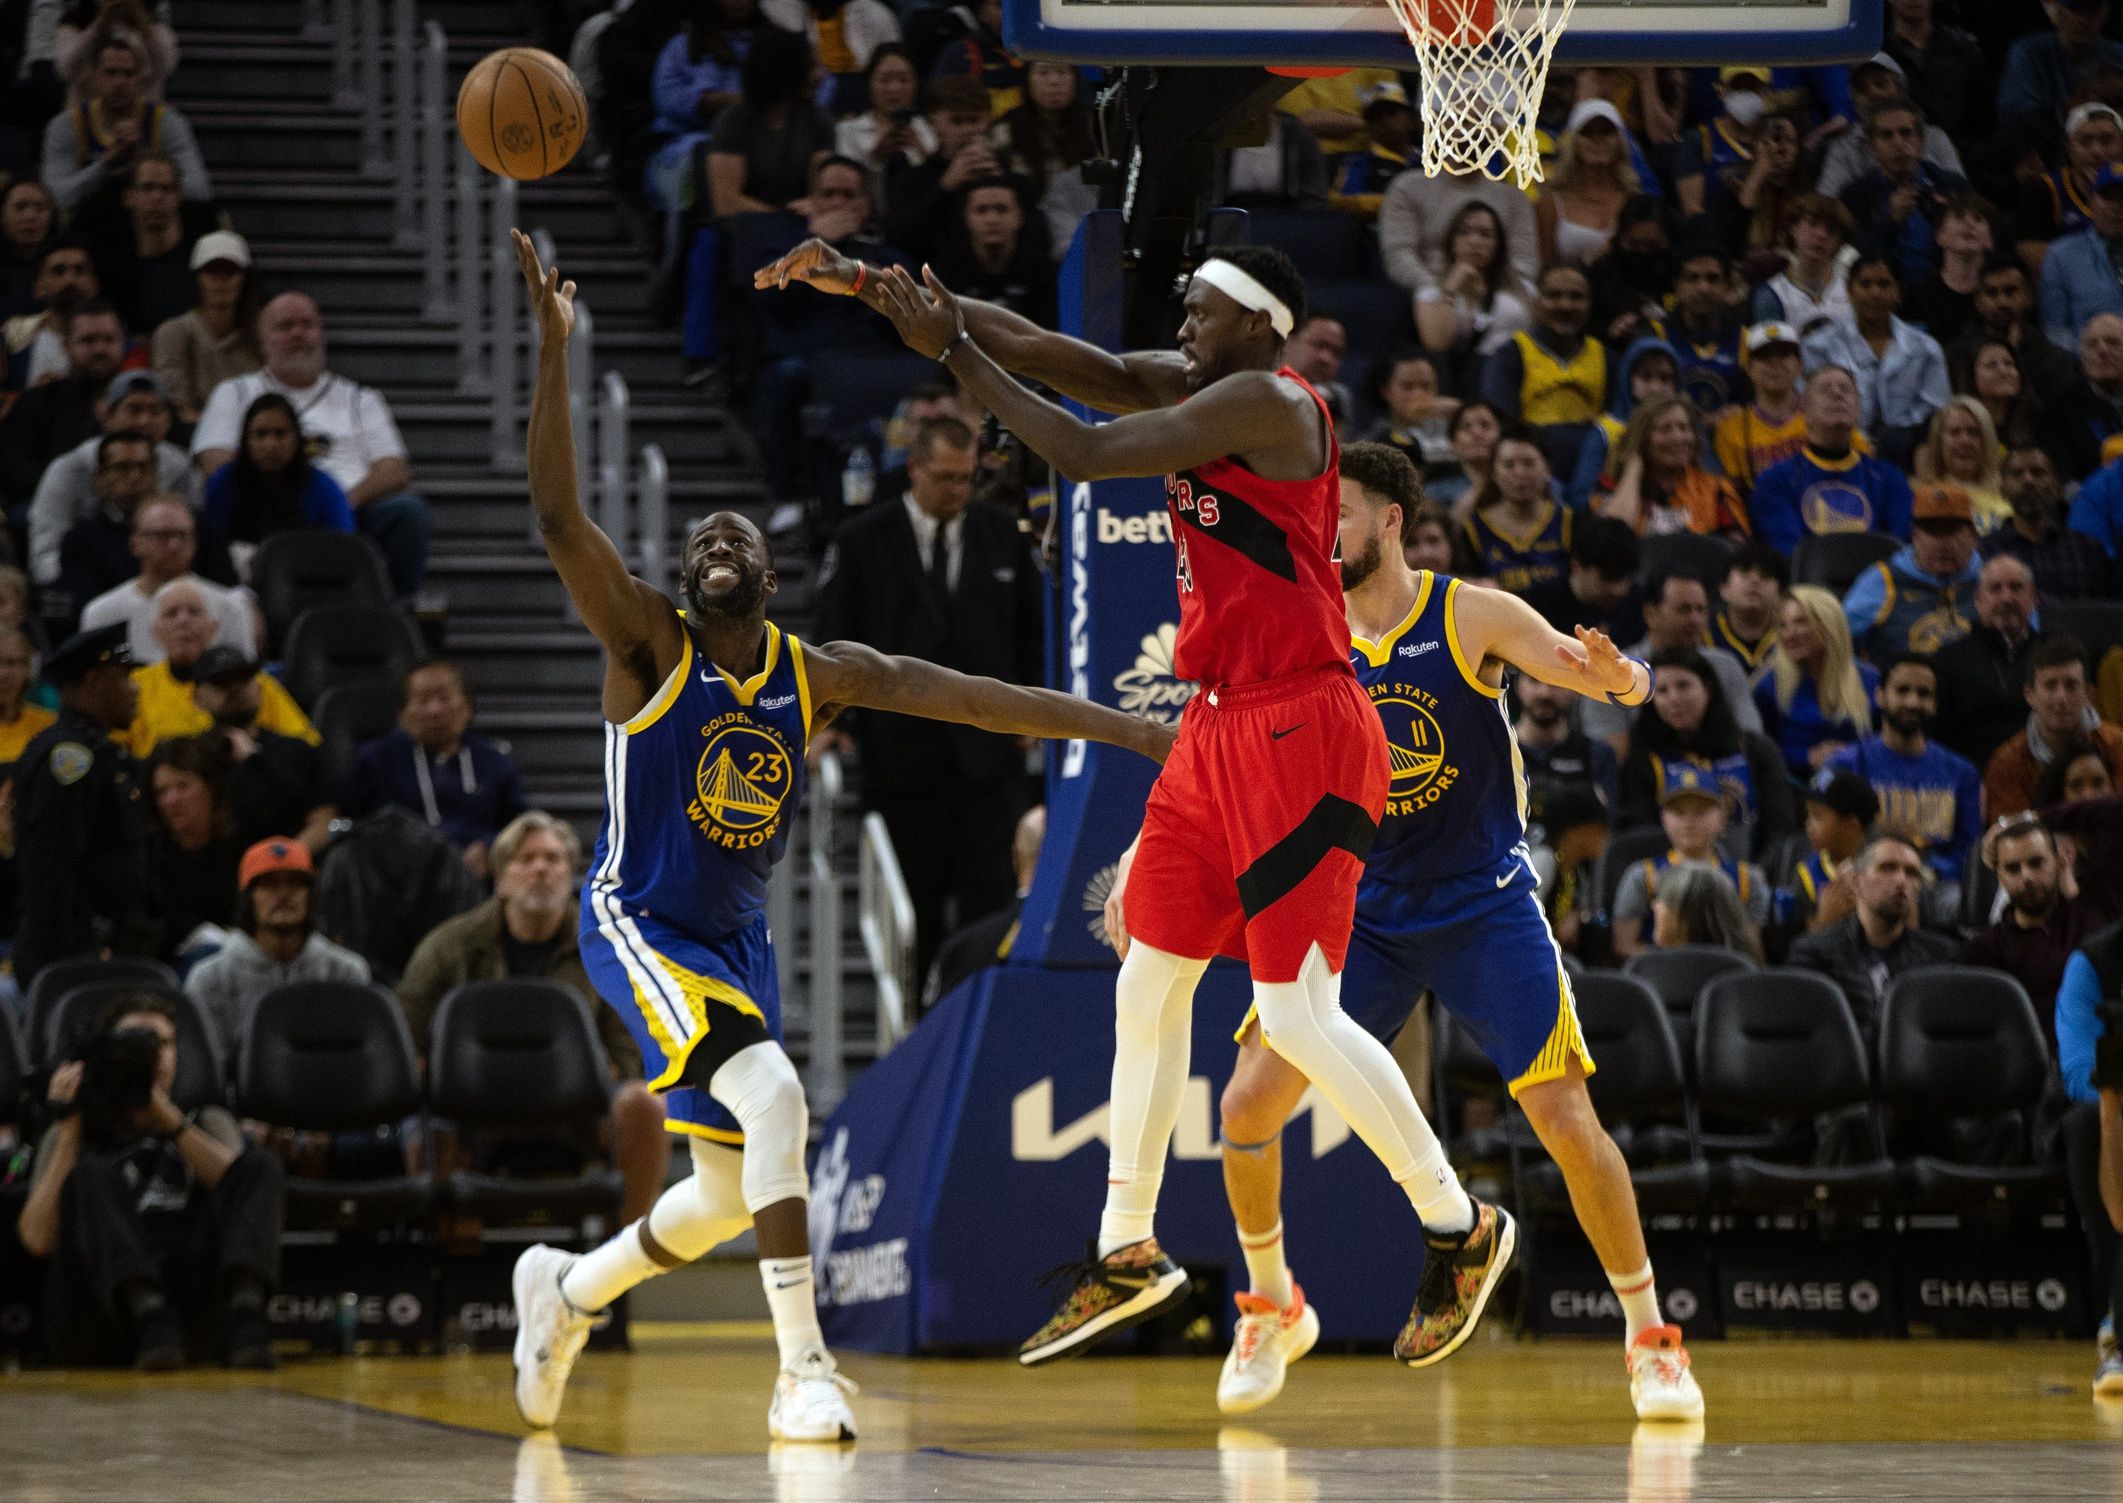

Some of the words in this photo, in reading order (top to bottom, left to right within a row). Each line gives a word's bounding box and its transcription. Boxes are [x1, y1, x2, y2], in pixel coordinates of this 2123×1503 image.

[1397, 640, 1440, 658] Rakuten
[1394, 682, 1439, 710] STATE
[1410, 718, 1429, 748] 11
[745, 751, 784, 783] 23
[685, 798, 782, 850] WARRIORS
[1733, 1281, 1844, 1311] CHASE
[1919, 1278, 2031, 1310] CHASE
